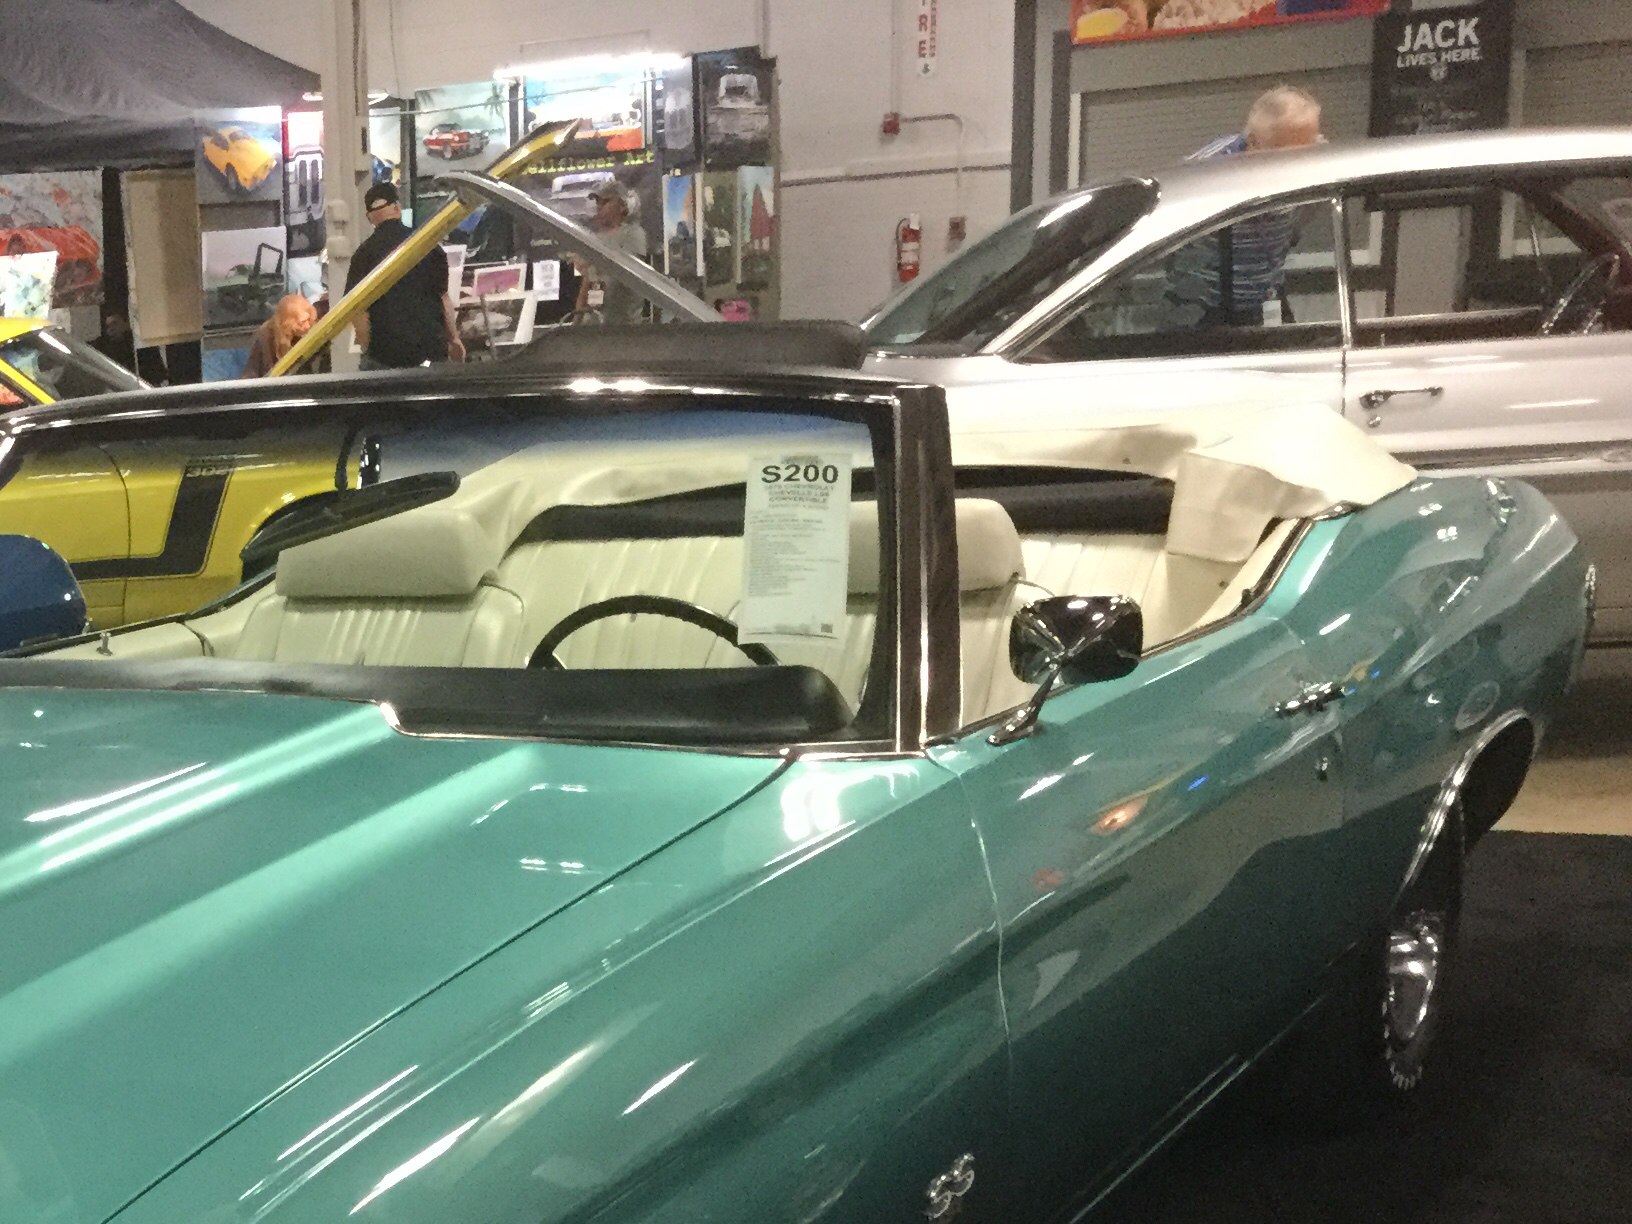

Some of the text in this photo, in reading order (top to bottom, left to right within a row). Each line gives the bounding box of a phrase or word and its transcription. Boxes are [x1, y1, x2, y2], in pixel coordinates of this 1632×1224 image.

[1396, 16, 1480, 53] JACK
[1396, 52, 1438, 69] LIVES
[760, 463, 840, 484] S200
[925, 1152, 975, 1220] SS
